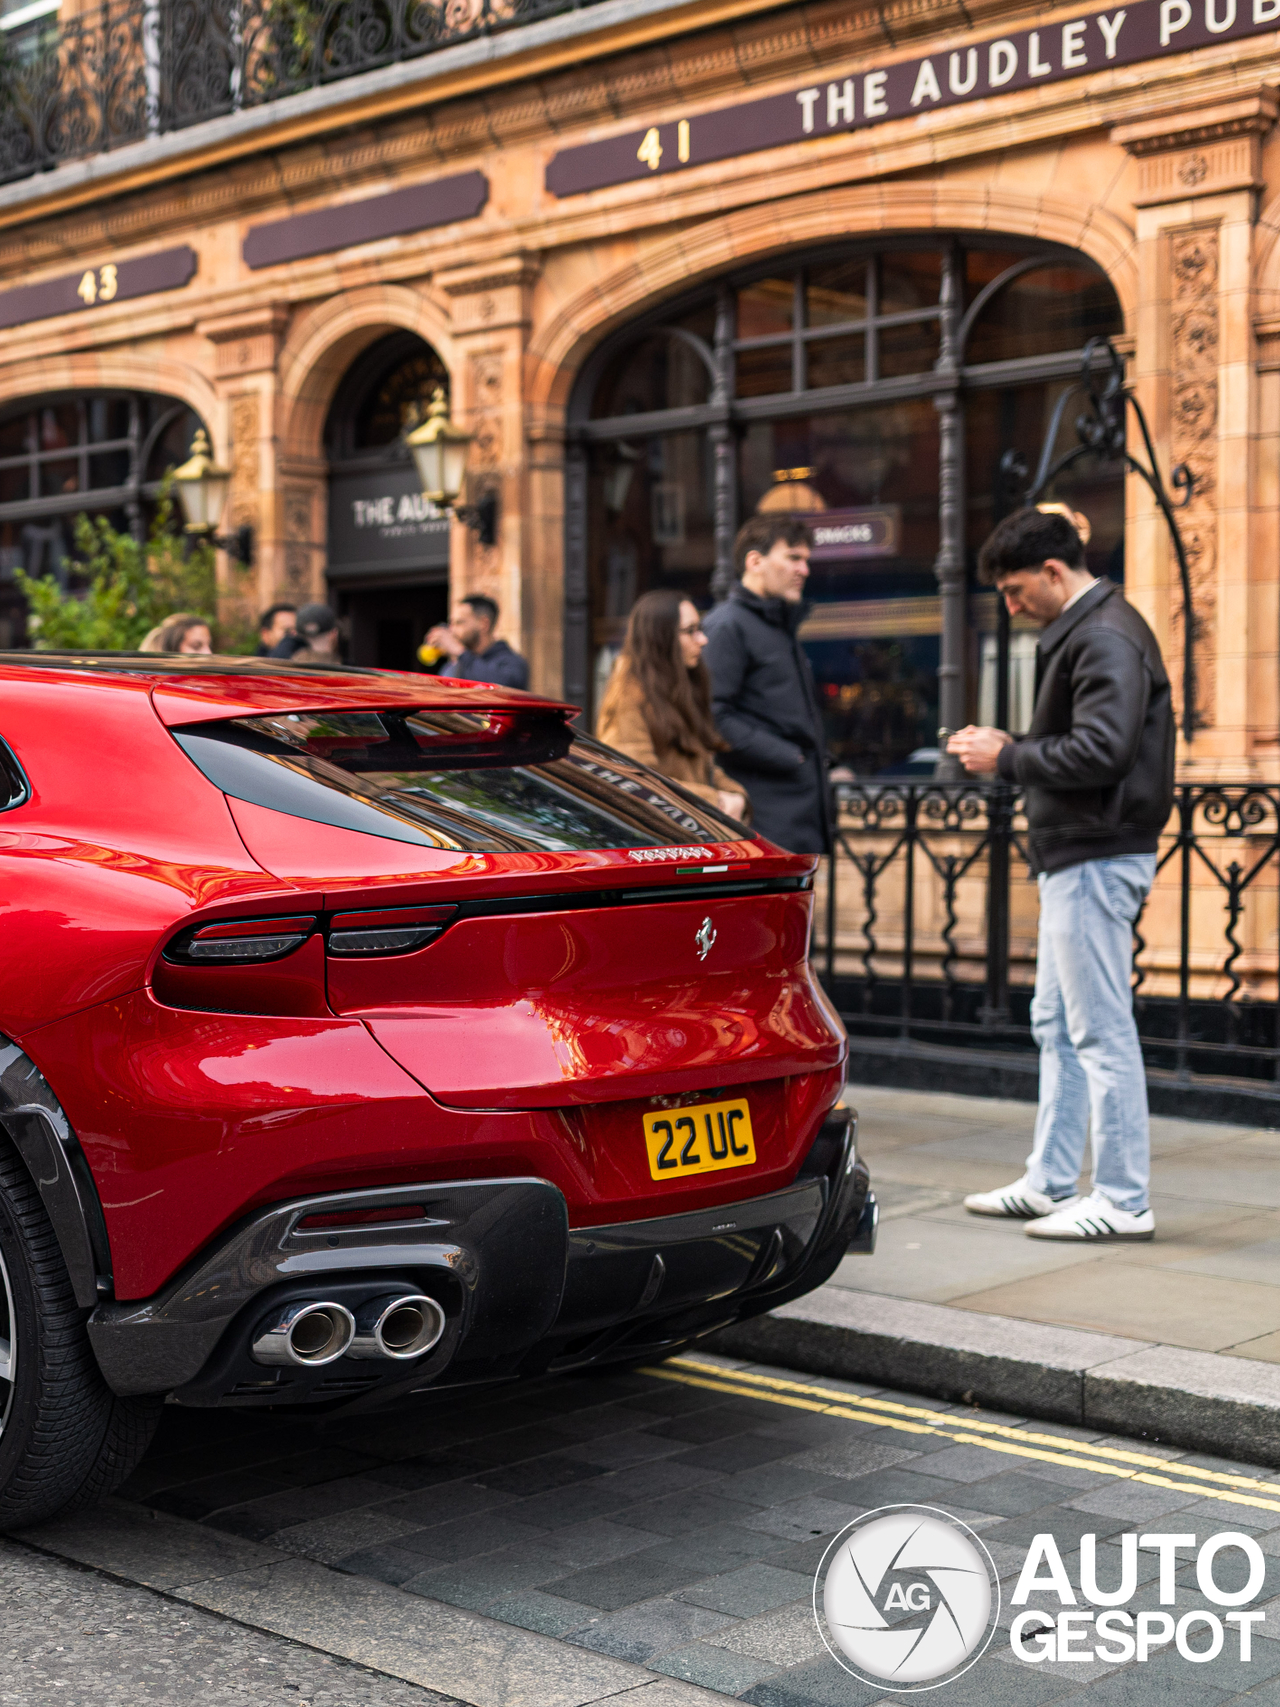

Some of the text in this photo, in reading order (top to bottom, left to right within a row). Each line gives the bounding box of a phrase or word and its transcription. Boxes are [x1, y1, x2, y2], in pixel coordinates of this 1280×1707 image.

[797, 71, 888, 133] THE
[910, 10, 1127, 107] AUDLEY
[637, 119, 690, 170] 41
[77, 264, 118, 305] 43
[353, 496, 395, 529] THE
[652, 1108, 749, 1170] 22 UC
